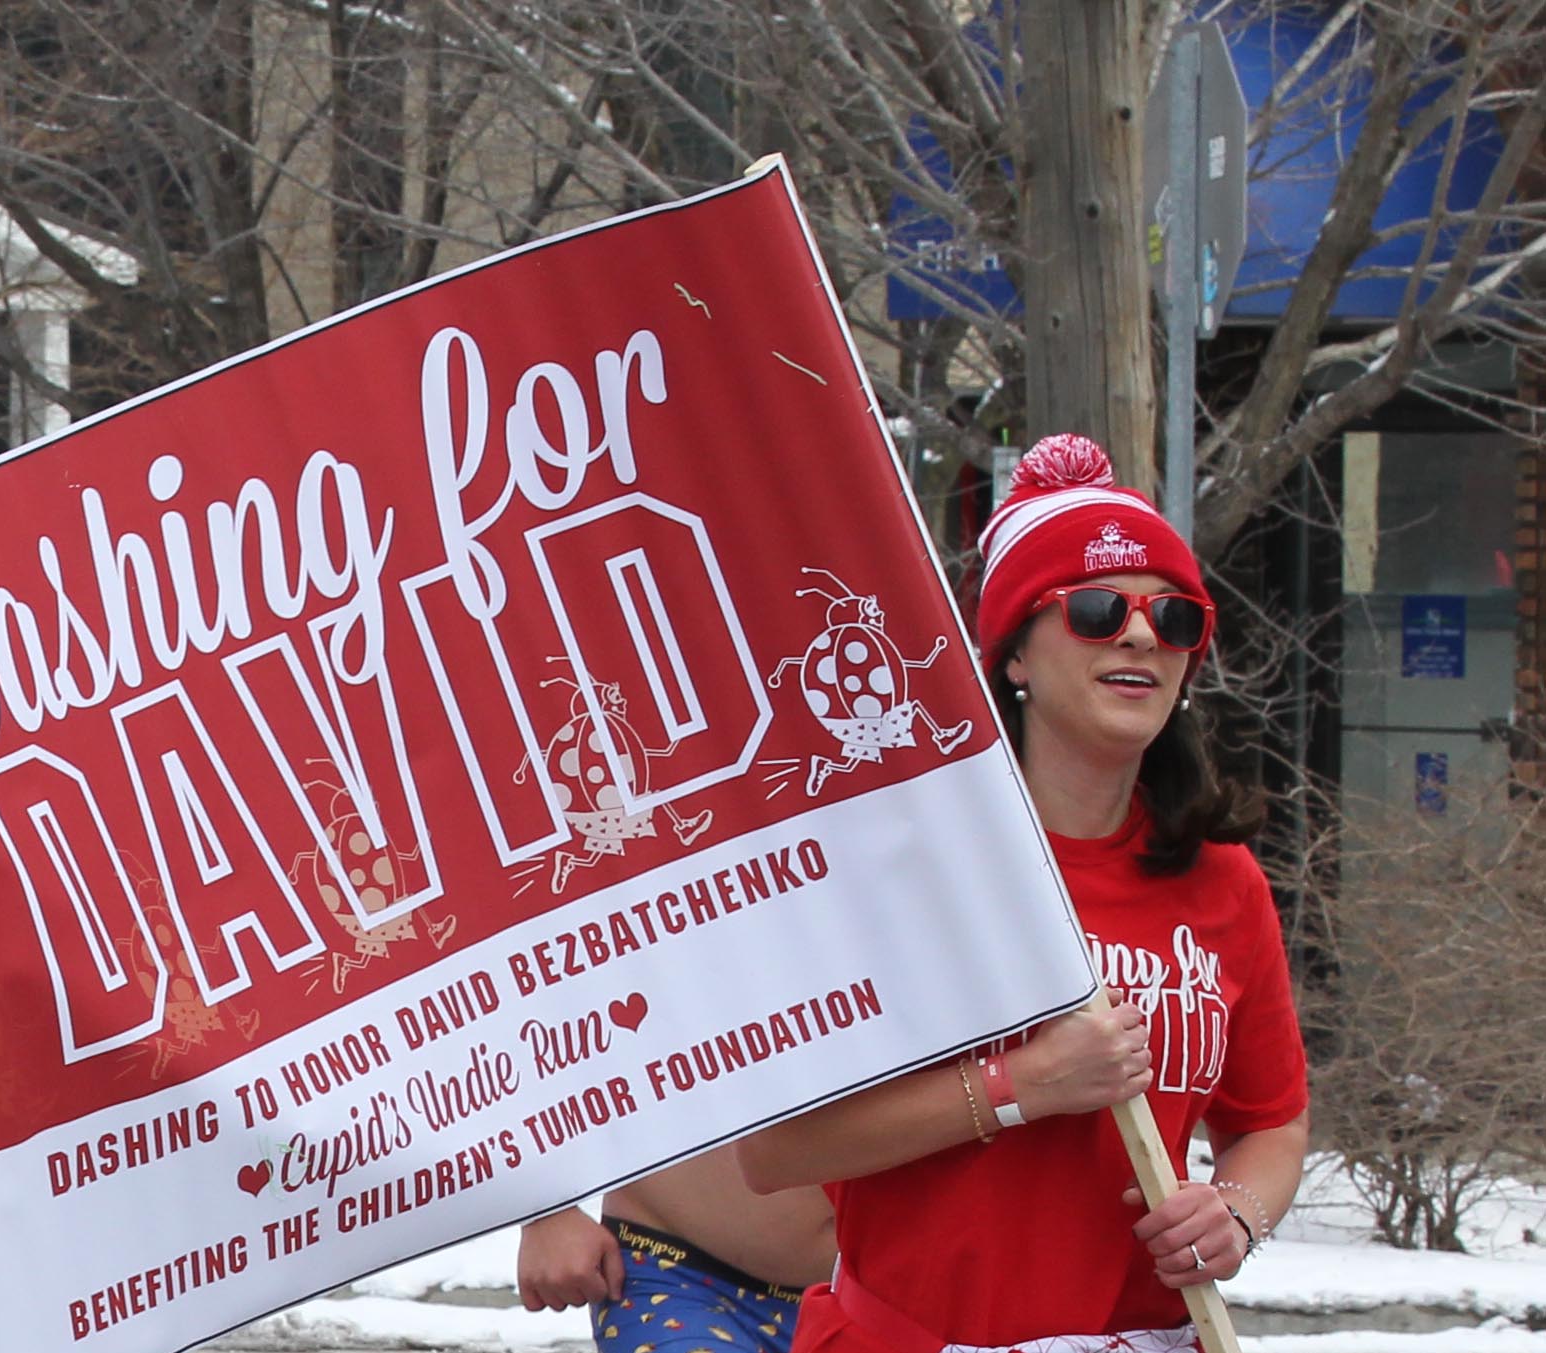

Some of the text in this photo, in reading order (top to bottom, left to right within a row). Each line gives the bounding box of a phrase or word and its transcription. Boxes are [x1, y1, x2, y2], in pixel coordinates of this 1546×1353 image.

[421, 327, 668, 621] for
[1083, 551, 1147, 572] DAVID
[47, 838, 829, 1197] DASHING TO HONOR DAVID BEZBATCHENKO
[69, 978, 884, 1342] BENEFITING THE CHILDREN'S TUMOR FOUNDATION
[280, 1010, 611, 1198] Cupid's Undie Run
